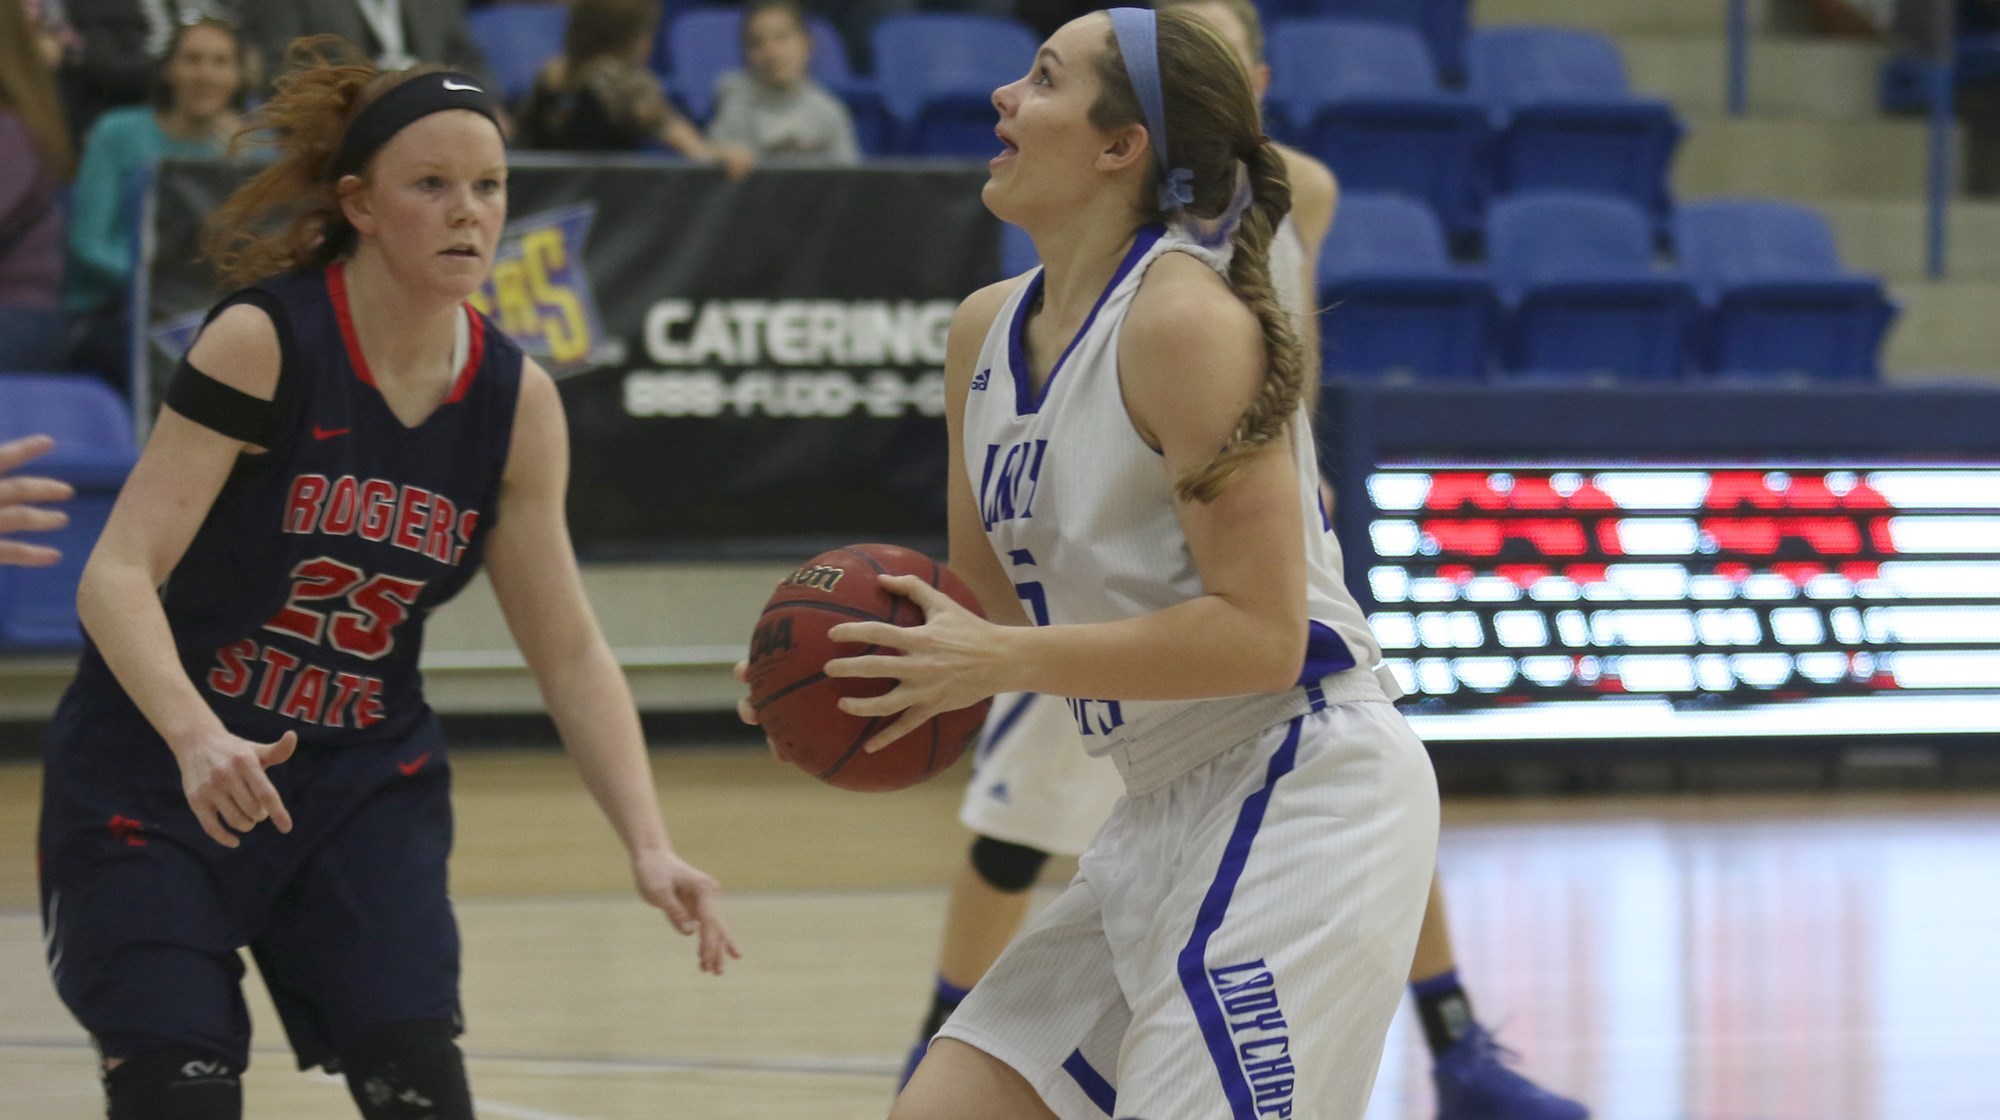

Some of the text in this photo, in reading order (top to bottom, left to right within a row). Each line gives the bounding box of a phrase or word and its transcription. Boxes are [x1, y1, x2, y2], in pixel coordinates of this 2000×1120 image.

[644, 299, 950, 366] CATERING
[282, 473, 481, 566] ROGERS
[261, 555, 429, 661] 25
[206, 638, 387, 730] STATE
[1208, 957, 1296, 1120] LADY CHAP
